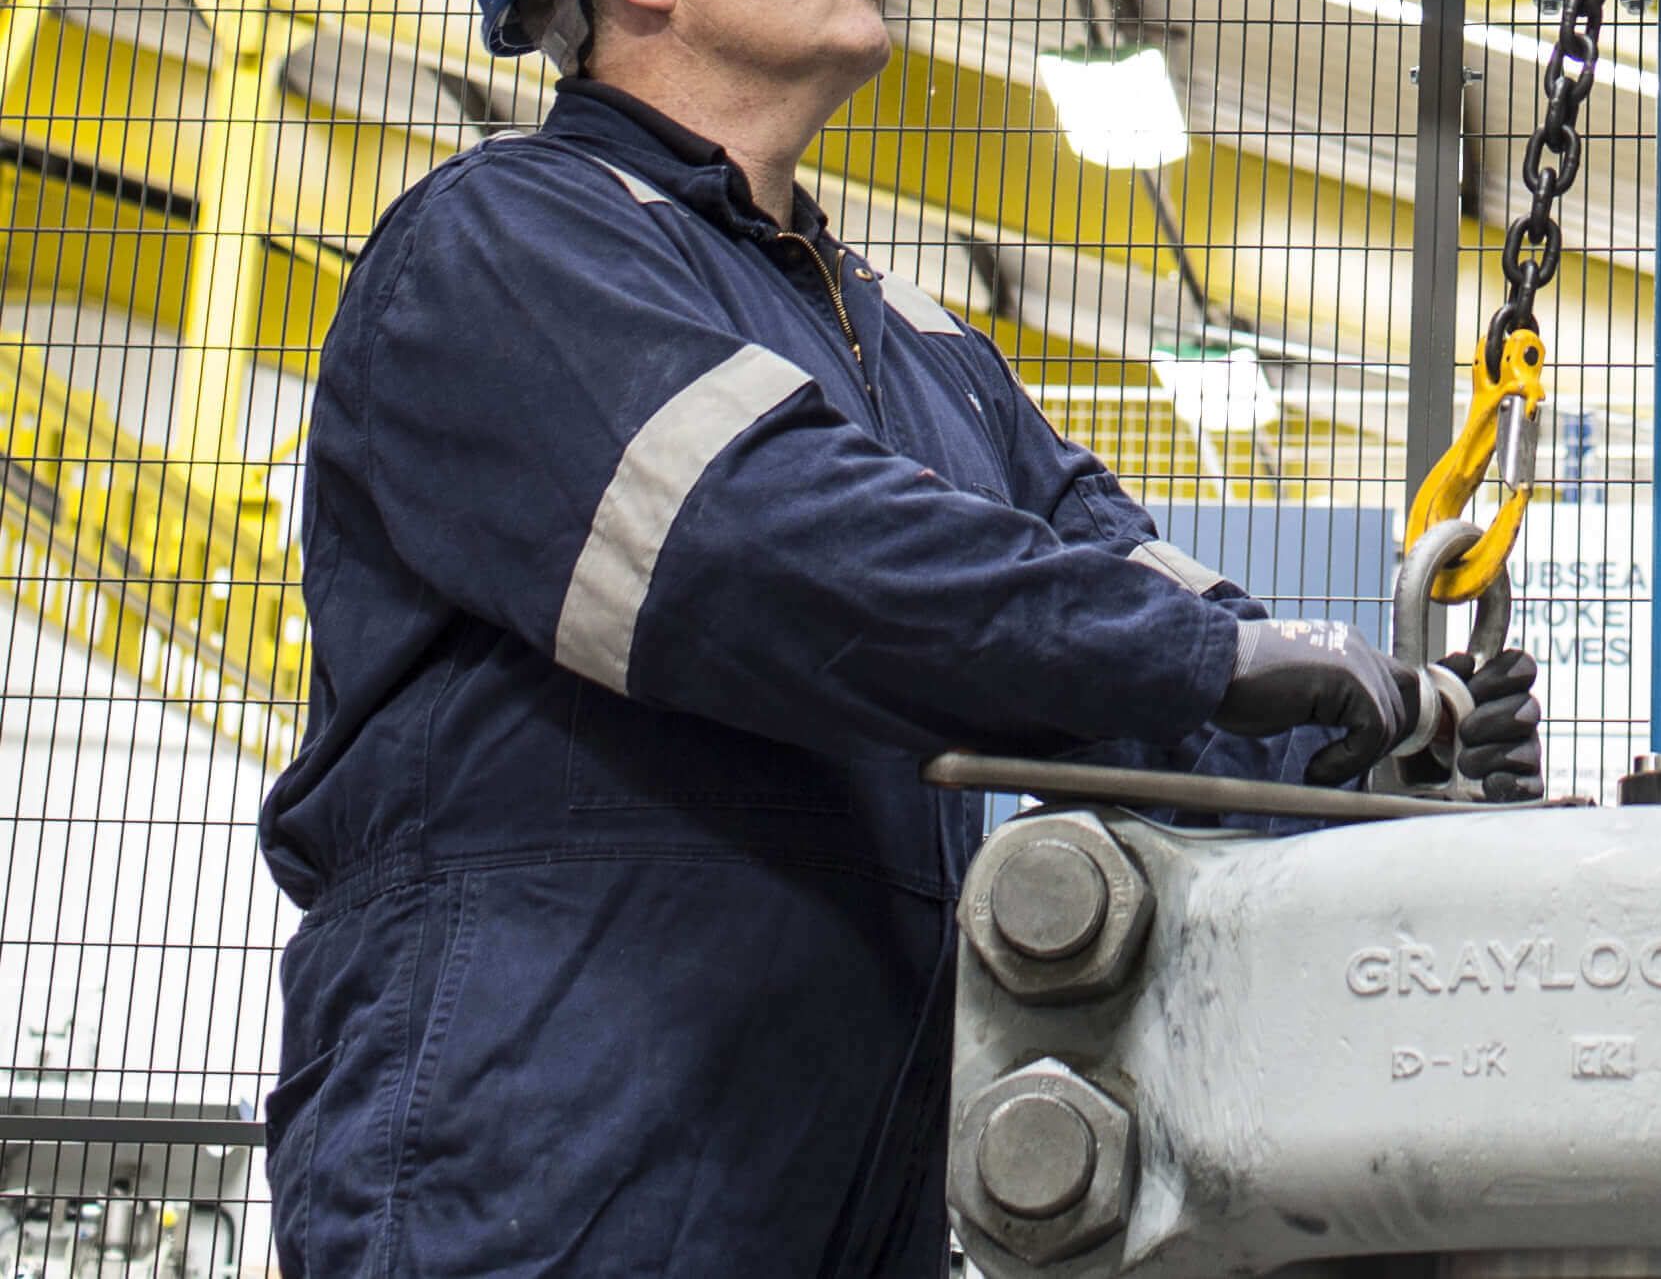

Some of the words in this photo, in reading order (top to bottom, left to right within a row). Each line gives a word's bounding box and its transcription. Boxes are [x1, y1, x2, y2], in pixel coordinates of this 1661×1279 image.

[1510, 560, 1646, 591] UBSEA
[1512, 600, 1626, 627] HOKE
[1512, 636, 1630, 666] LVES
